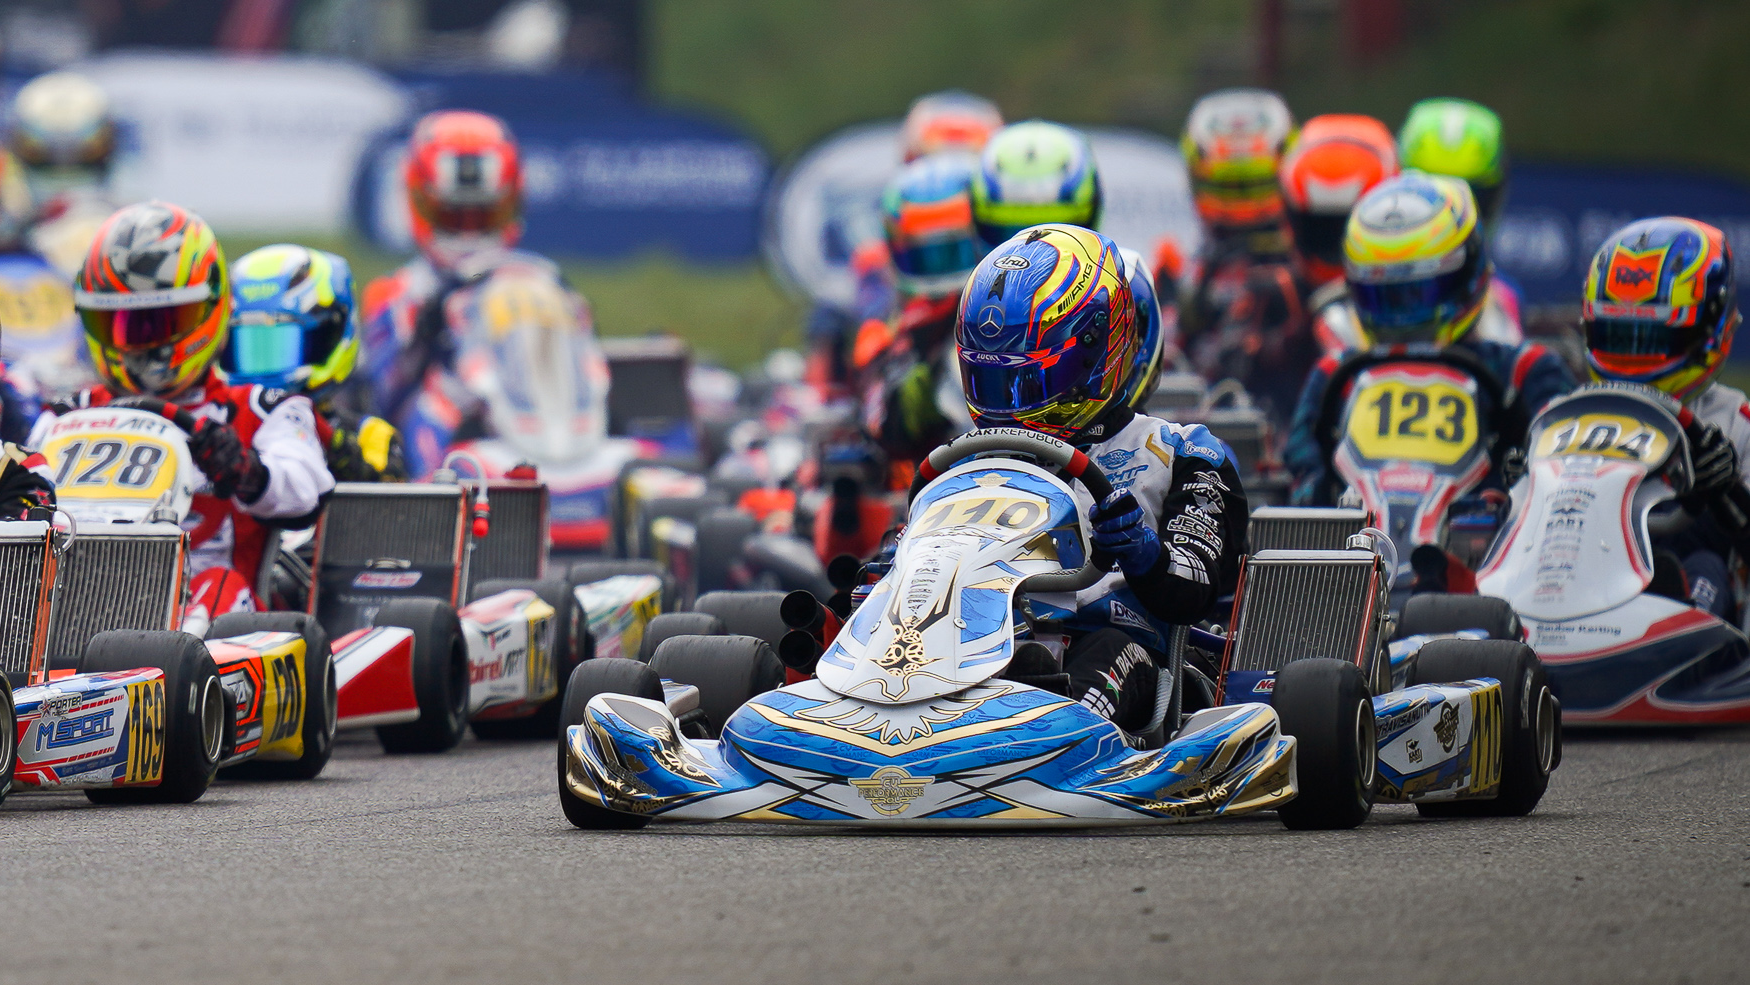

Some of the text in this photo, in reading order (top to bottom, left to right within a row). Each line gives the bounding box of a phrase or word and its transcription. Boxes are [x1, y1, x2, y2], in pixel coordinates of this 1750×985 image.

[998, 255, 1027, 267] Arai
[1071, 263, 1093, 301] AMG
[976, 353, 1000, 361] LUCKY
[1370, 390, 1467, 443] 123
[1550, 419, 1657, 460] 104
[54, 438, 169, 491] 128
[923, 498, 1041, 530] 110
[50, 696, 82, 710] PORTER
[131, 681, 165, 782] 169
[858, 787, 925, 798] PERFORMANCE
[872, 796, 910, 804] GROUP
